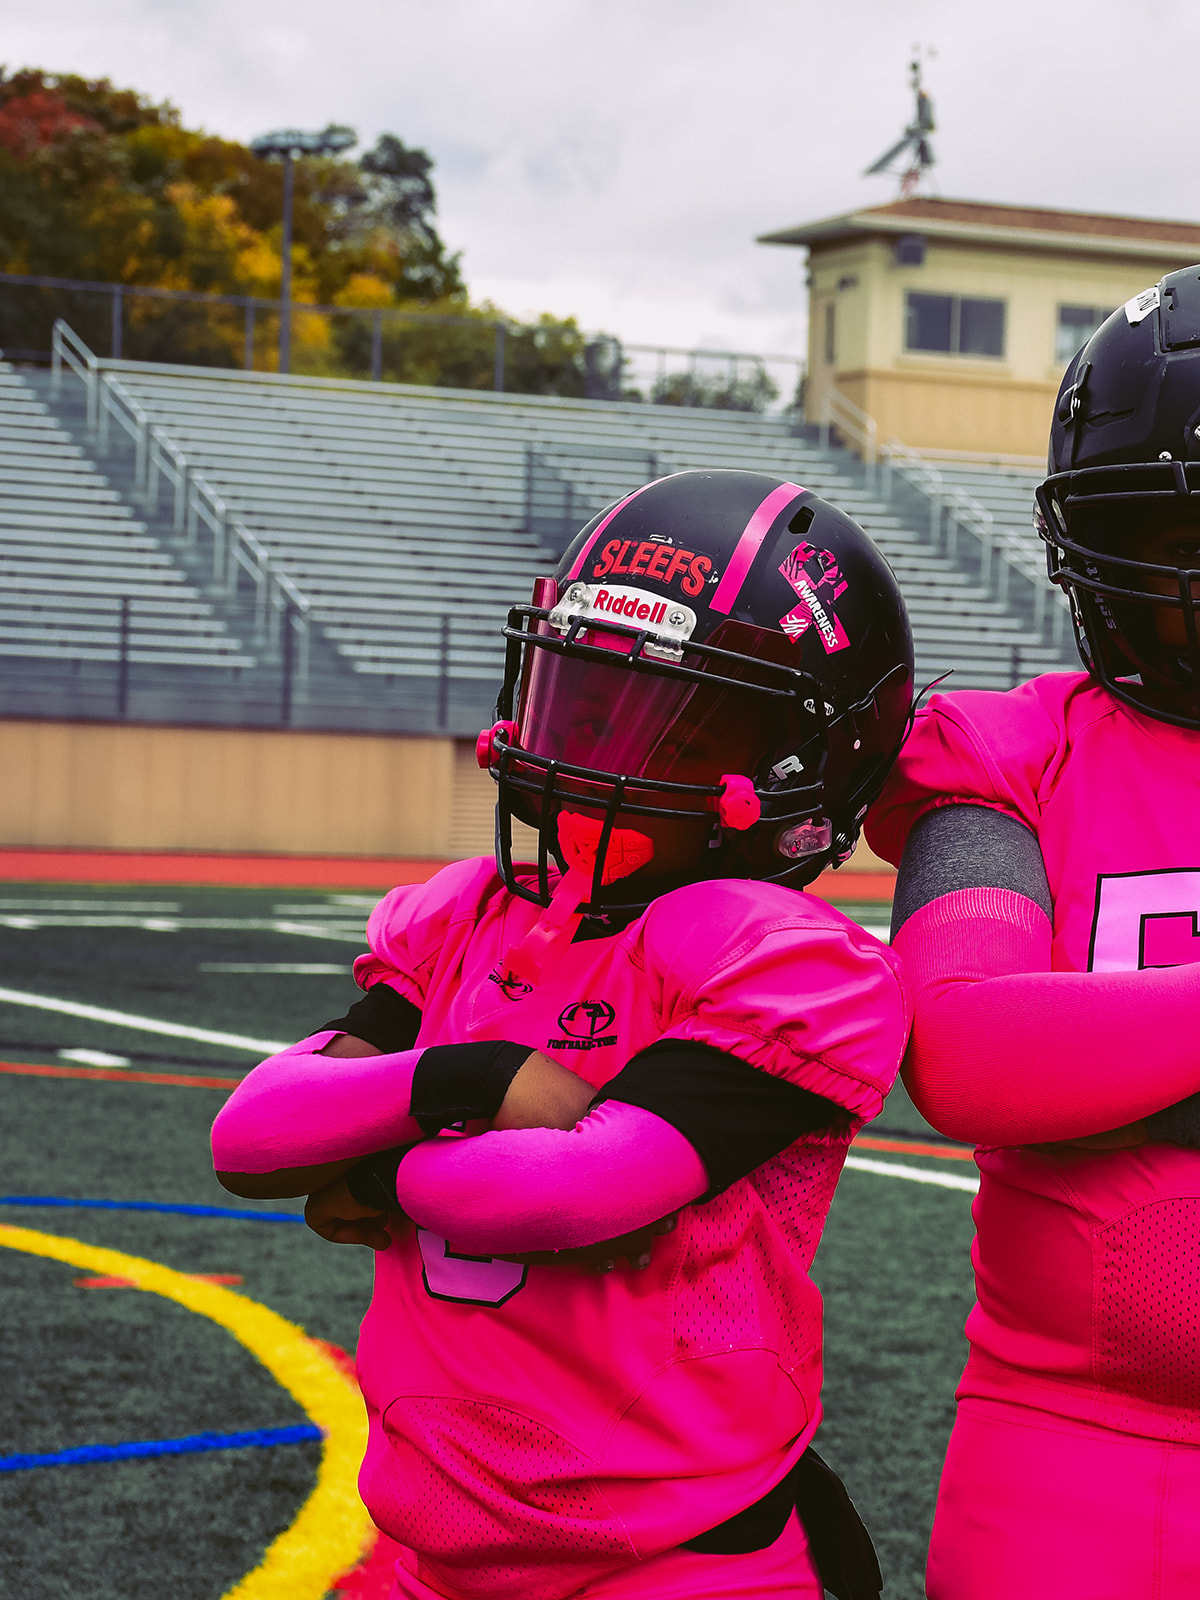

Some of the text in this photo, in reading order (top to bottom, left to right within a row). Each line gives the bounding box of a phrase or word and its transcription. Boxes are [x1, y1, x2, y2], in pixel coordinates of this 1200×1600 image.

[593, 539, 713, 598] SLEEFS
[593, 589, 668, 625] Riddell
[794, 579, 838, 648] AWARENESS
